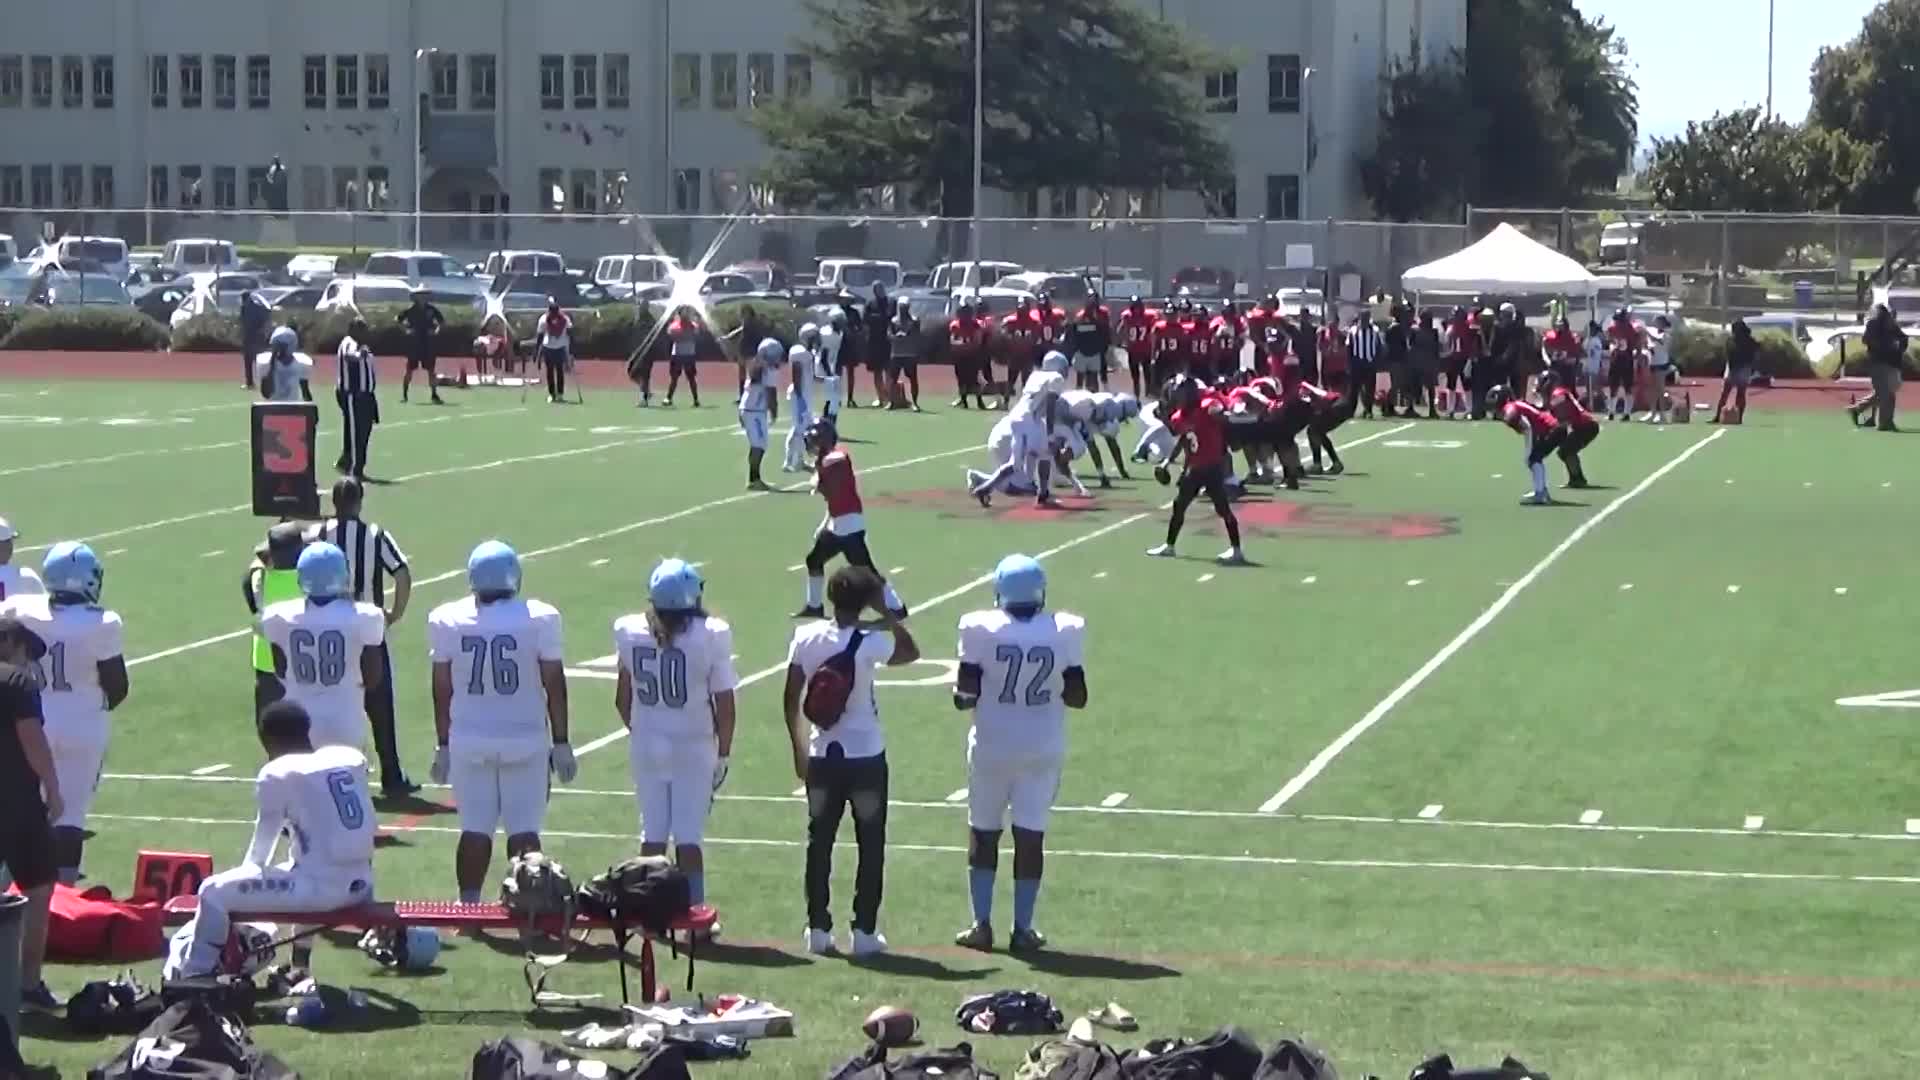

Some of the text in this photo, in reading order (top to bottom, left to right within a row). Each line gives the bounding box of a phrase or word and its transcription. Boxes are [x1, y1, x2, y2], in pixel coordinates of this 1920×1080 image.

[262, 414, 308, 473] 3
[289, 628, 346, 687] 68
[461, 634, 519, 696] 76
[632, 646, 689, 708] 50
[996, 645, 1055, 707] 72
[327, 770, 364, 831] 6
[144, 860, 202, 904] 50
